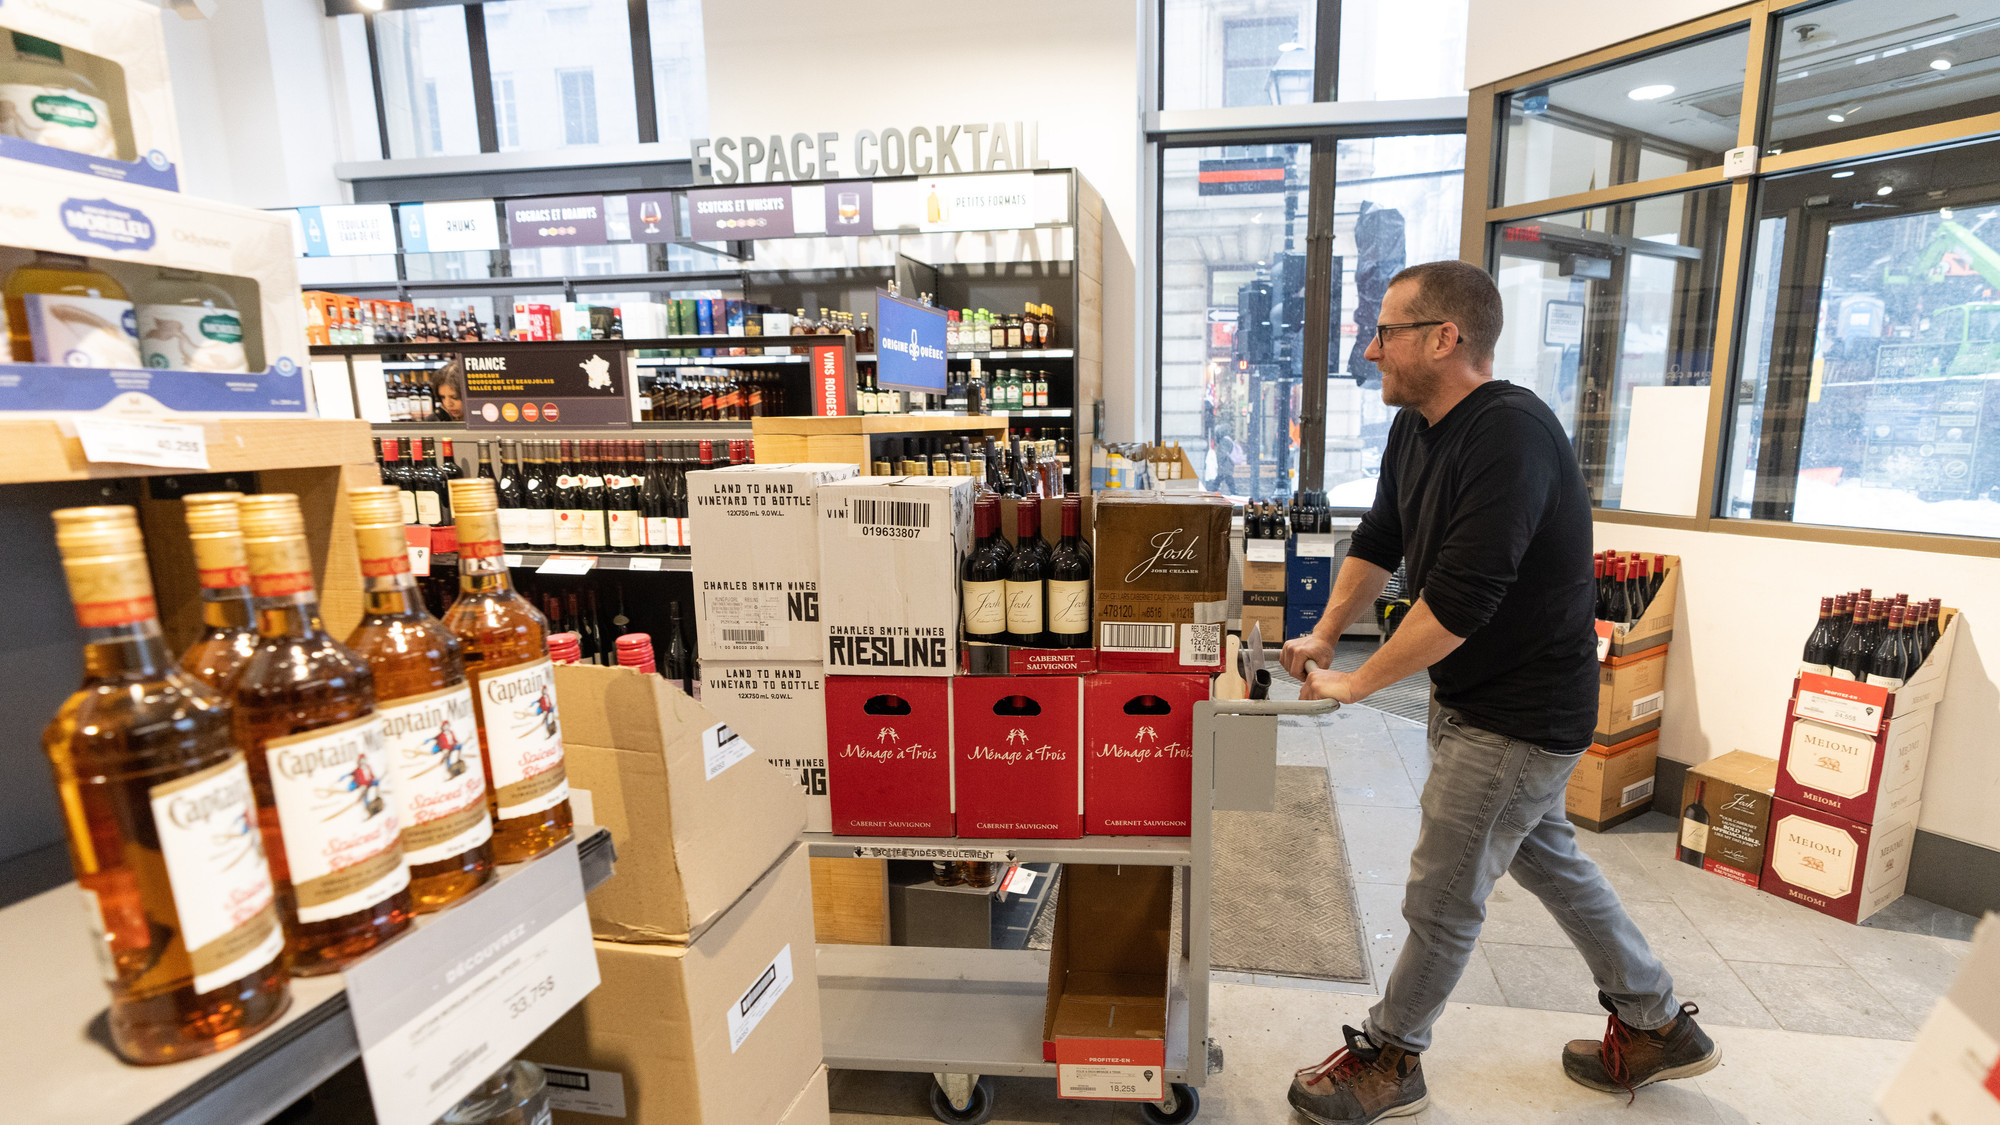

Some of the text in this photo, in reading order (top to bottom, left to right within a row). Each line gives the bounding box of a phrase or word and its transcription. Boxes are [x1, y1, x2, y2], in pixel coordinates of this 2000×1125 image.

[690, 120, 1051, 185] ESPACE COCKTAIL
[697, 199, 734, 214] SCOTCHS
[734, 199, 746, 212] ET
[956, 194, 1026, 208] PETITS FORMATS
[551, 208, 561, 221] ET
[446, 219, 476, 232] RHUMS
[882, 337, 944, 360] ORIGINE QUÉBEC
[464, 356, 507, 371] FRANCE
[823, 351, 838, 416] VINS ROUGES
[714, 484, 793, 494] LAND TO HAND
[697, 495, 811, 506] VINEYARD TO BOTTLE
[862, 526, 921, 539] 019633807
[1124, 528, 1200, 583] Josh
[704, 581, 817, 591] CHARLES SMITH WINES
[1103, 605, 1133, 618] 478120
[830, 625, 944, 636] CHARLES SMITH WINES
[829, 635, 947, 667] RIESLING
[726, 669, 801, 679] LAND TO HAND
[1026, 663, 1078, 671] SAUVIGNON
[710, 680, 820, 690] VINEYARD TO BOTTLE
[382, 704, 443, 739] aptain
[1803, 734, 1859, 757] MEIOMI
[839, 743, 937, 764] Ménage à Trois
[967, 744, 1067, 765] Ménage à Trois
[1096, 743, 1152, 763] Ménage
[1155, 747, 1164, 758] à
[796, 759, 824, 767] WINES
[1720, 793, 1757, 811] Josh
[1803, 791, 1842, 809] MEIOMI
[850, 820, 931, 828] CABERNET SAUVIGNON
[976, 822, 1059, 831] CABERNET SAUVIGNON
[1104, 819, 1187, 827] CABERNET SAUVIGNON
[1723, 824, 1741, 834] BOLD
[1788, 833, 1842, 857] MEIOMI
[912, 849, 938, 858] VIDES
[941, 849, 994, 859] SEULEMENT
[1715, 864, 1746, 878] CABERNET
[1788, 888, 1827, 908] MEIOMI
[444, 923, 527, 984] DÉCOUVREZ
